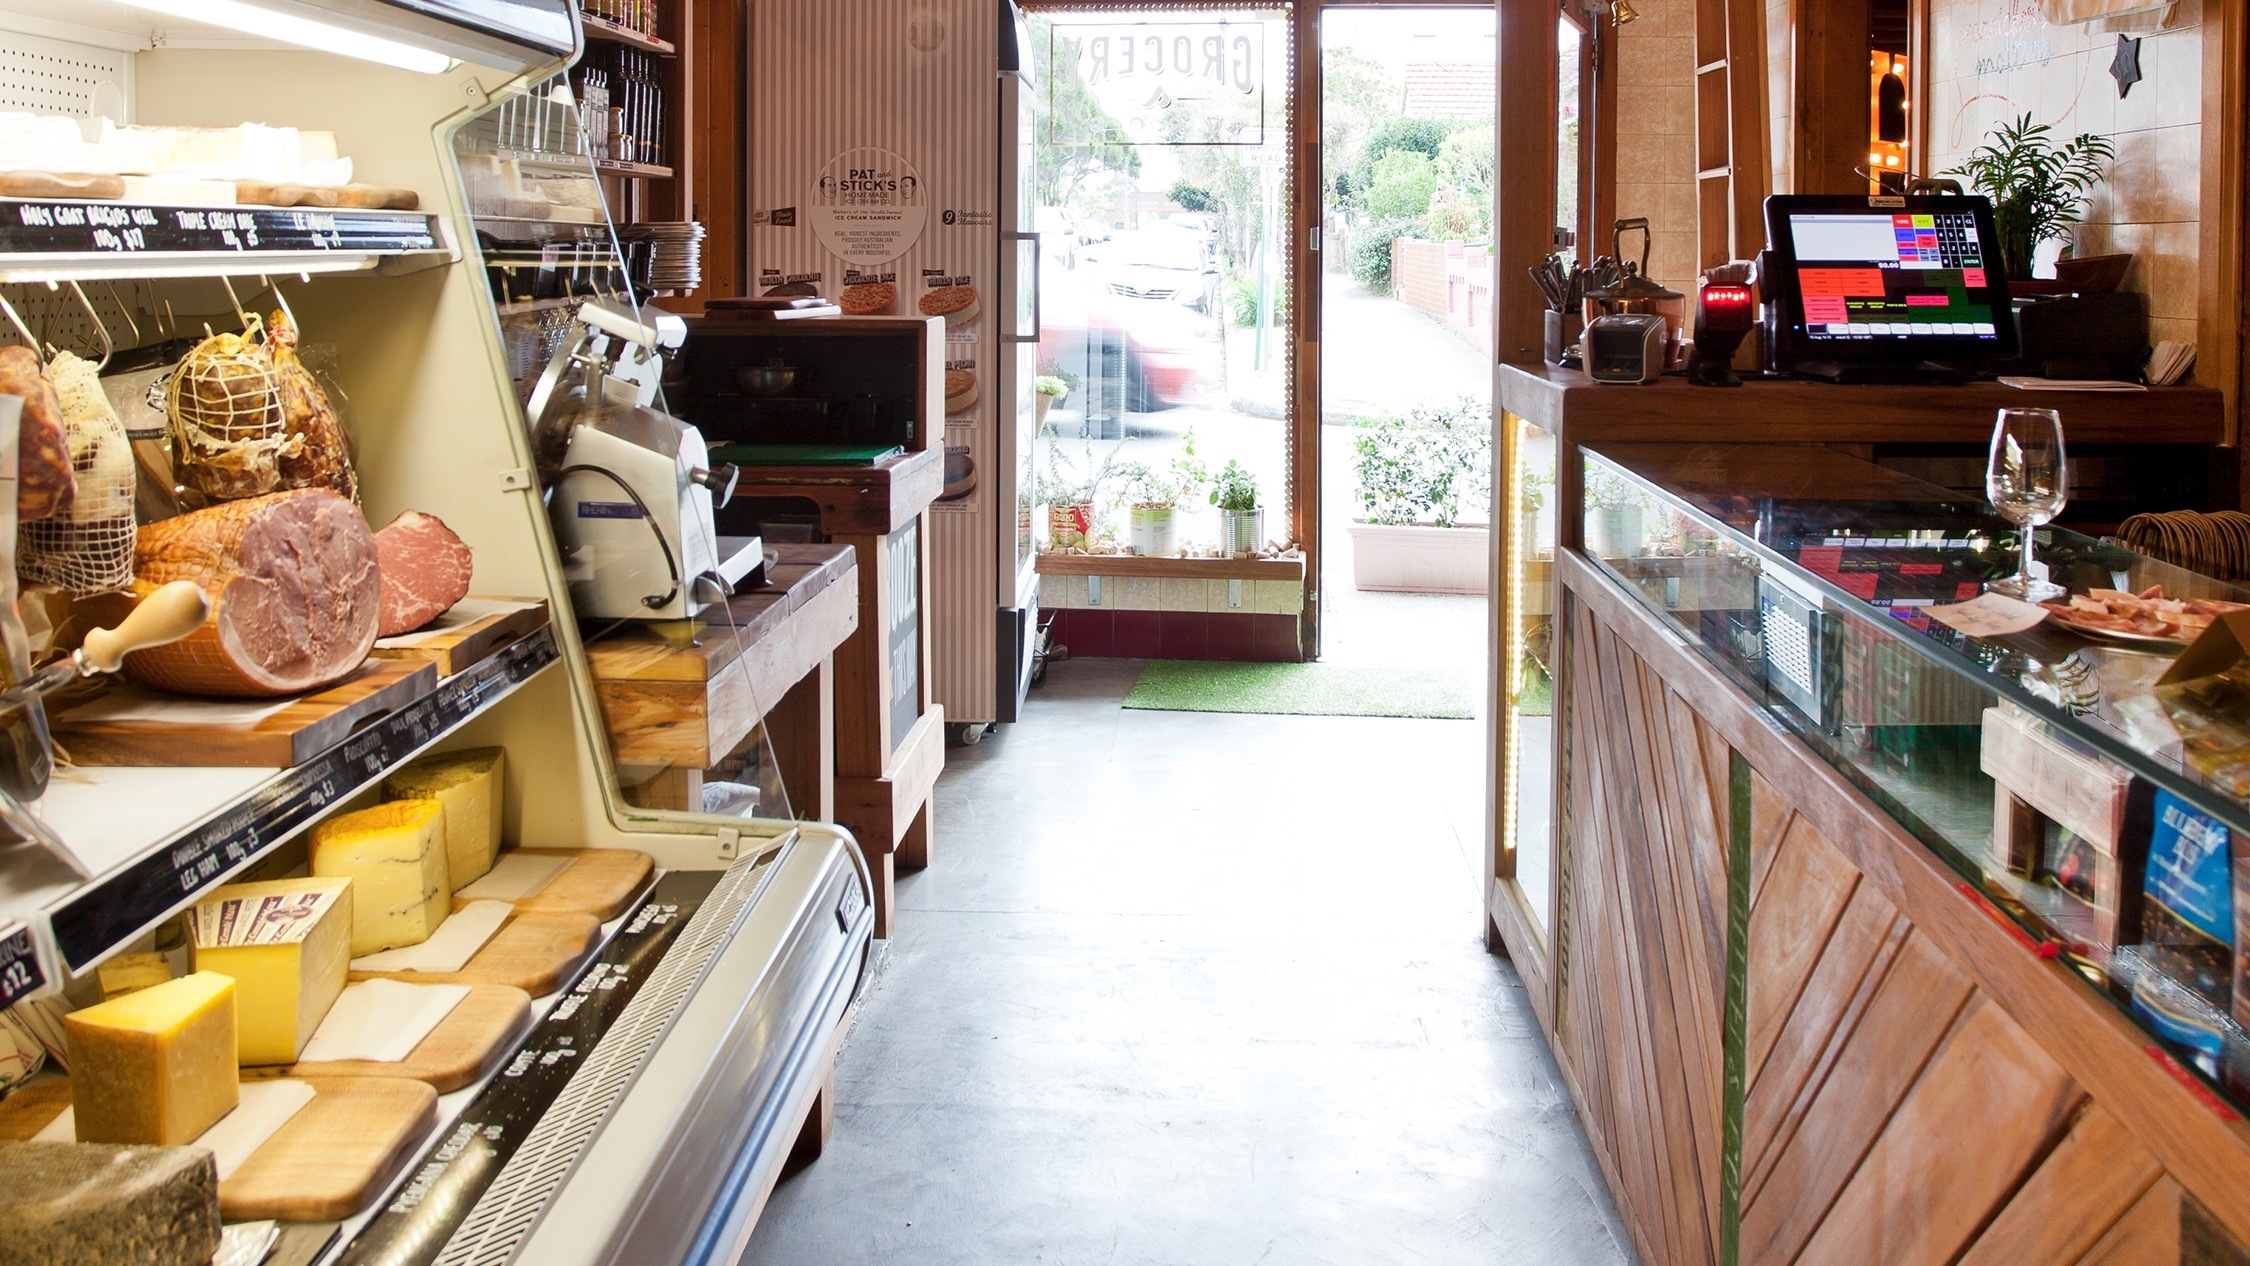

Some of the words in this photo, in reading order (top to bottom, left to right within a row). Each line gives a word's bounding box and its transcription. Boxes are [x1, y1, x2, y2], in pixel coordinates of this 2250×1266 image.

[849, 169, 876, 180] PAT
[877, 170, 892, 179] and
[840, 180, 897, 191] STICK'S
[20, 204, 54, 227] HOLY
[54, 205, 86, 226] GOAT
[176, 210, 207, 230] TRIPLE
[945, 211, 953, 224] 9
[957, 210, 993, 218] Fantastic
[957, 217, 993, 226] Flavours
[843, 273, 879, 286] CHOCOLATE
[179, 866, 199, 892] LEG
[197, 852, 221, 880] HAM
